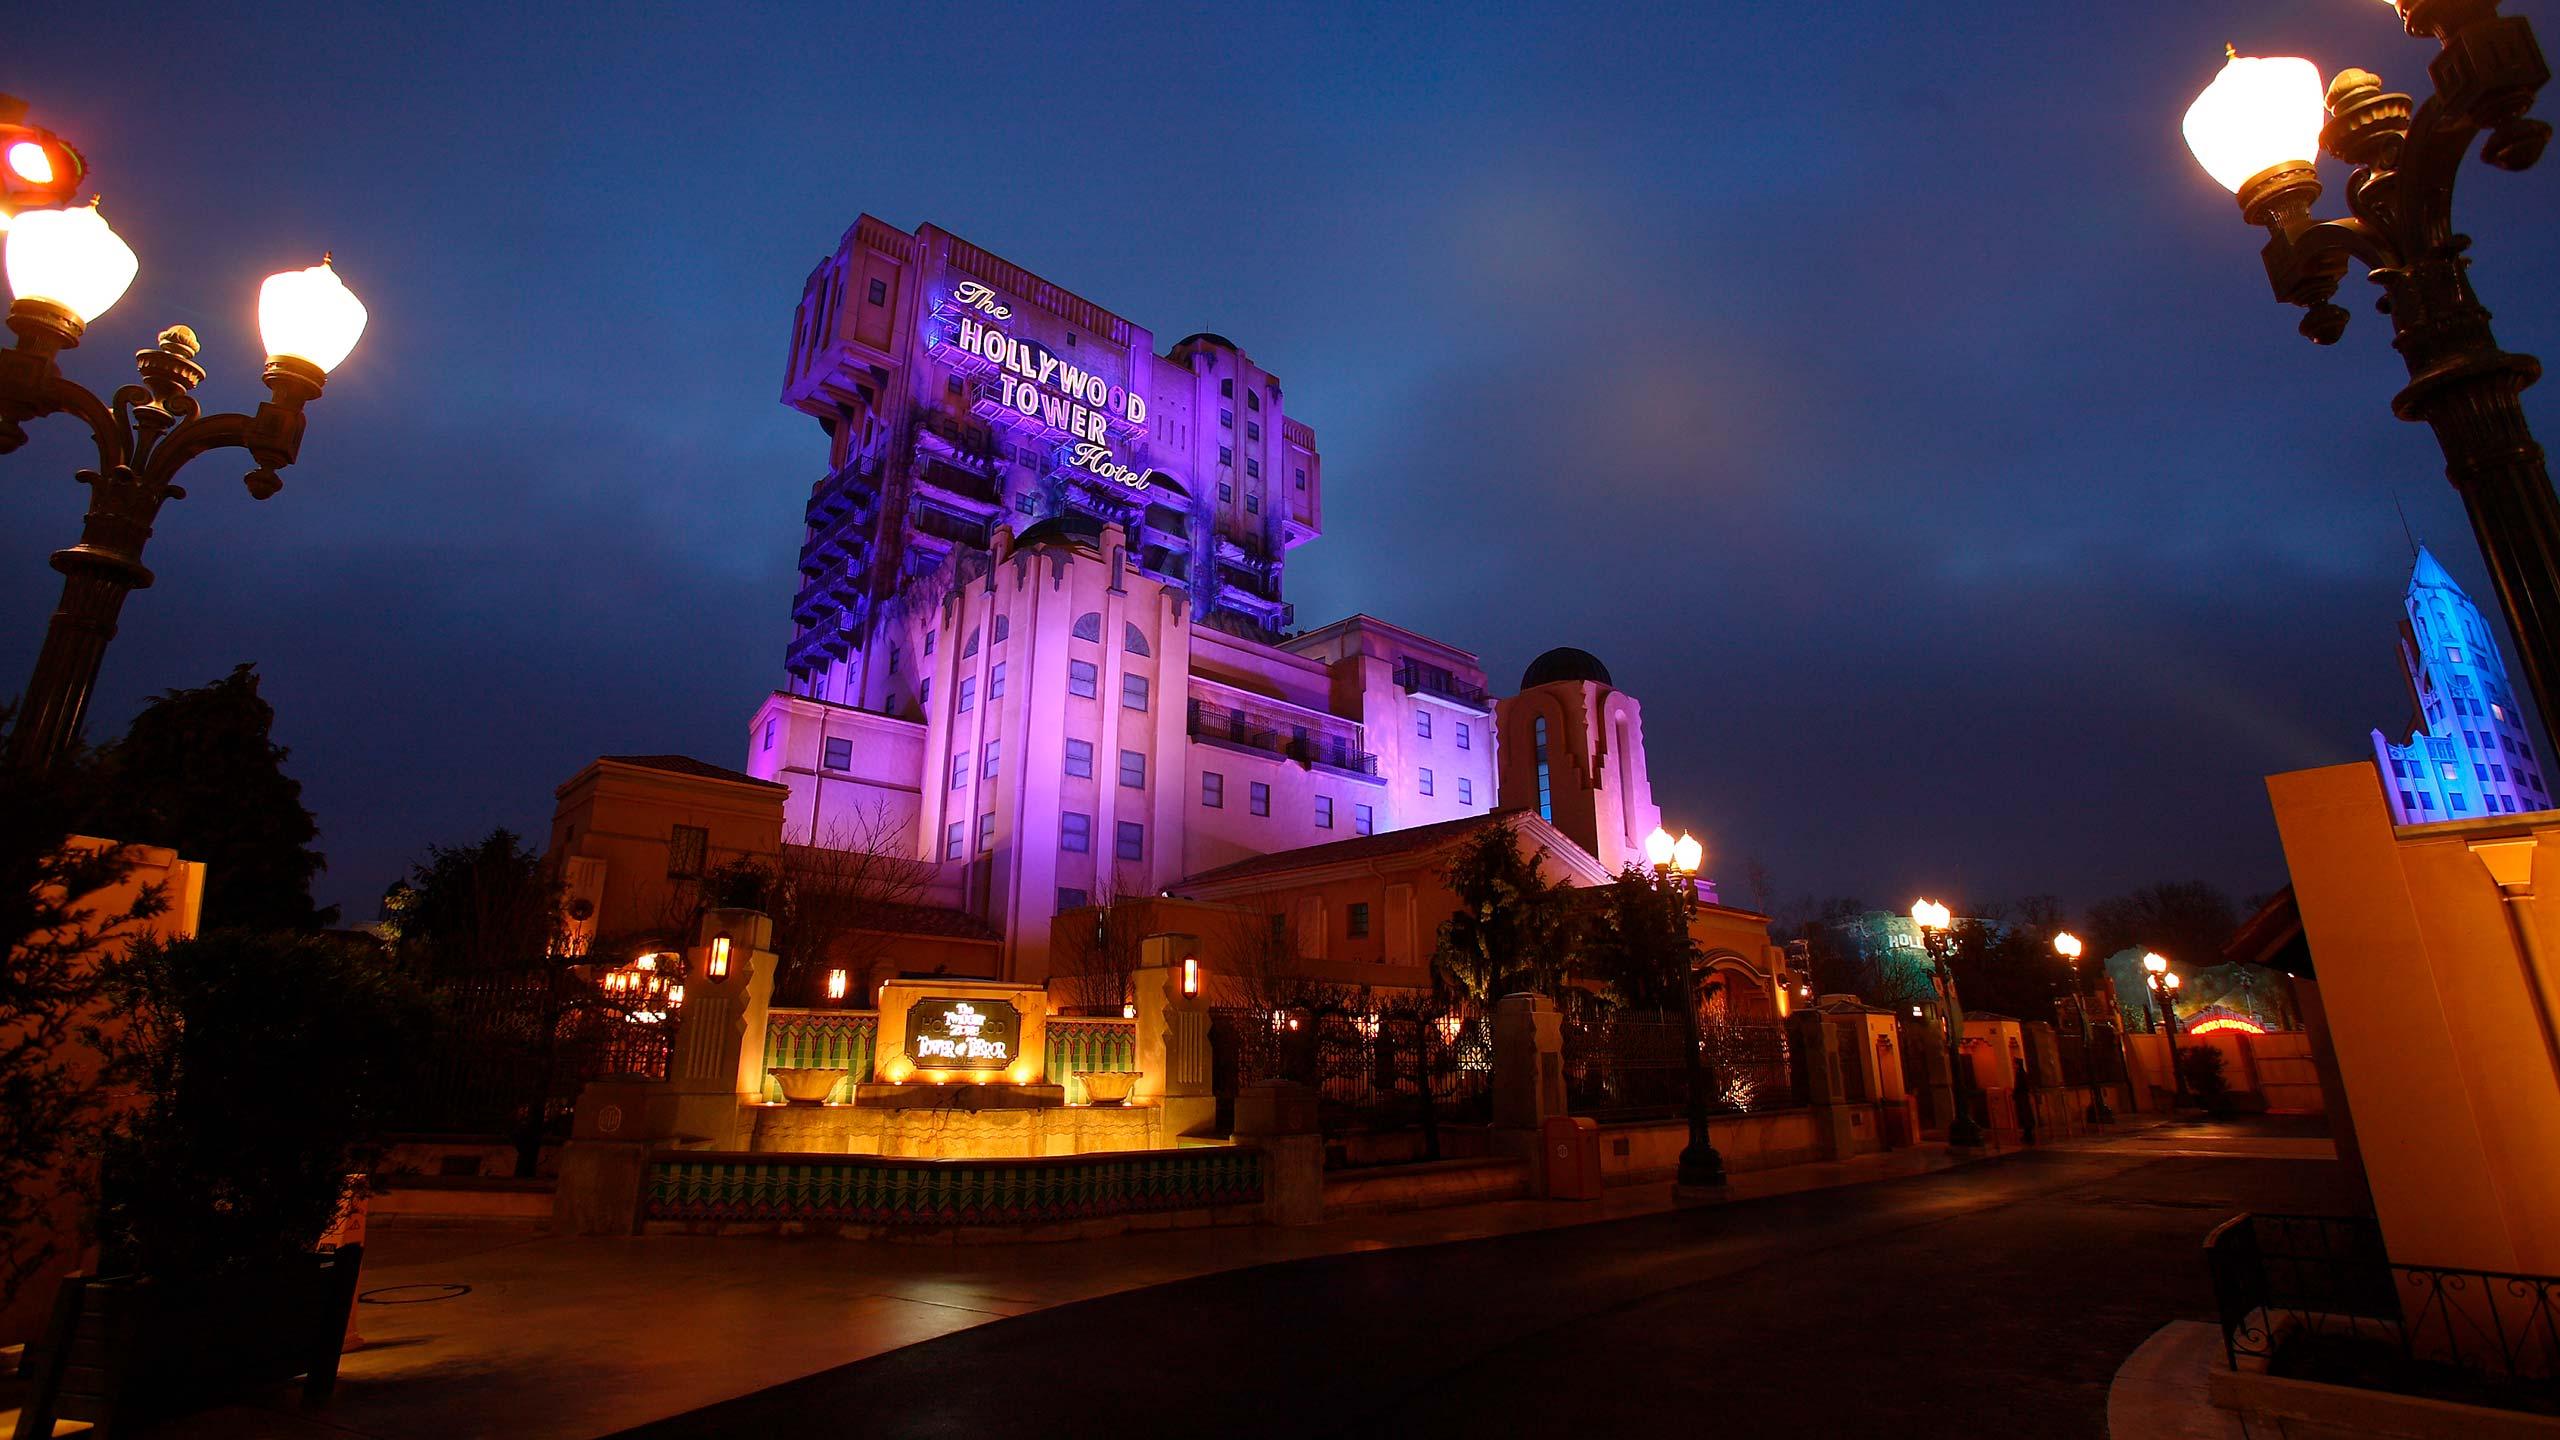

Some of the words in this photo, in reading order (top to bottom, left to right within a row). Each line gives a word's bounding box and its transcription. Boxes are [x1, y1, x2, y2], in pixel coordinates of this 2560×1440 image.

[954, 281, 1012, 319] The
[959, 318, 1146, 424] HOLLYWOOD
[1000, 373, 1107, 445] TOWER
[1069, 443, 1153, 490] Hotel
[916, 1035, 956, 1058] TOWER
